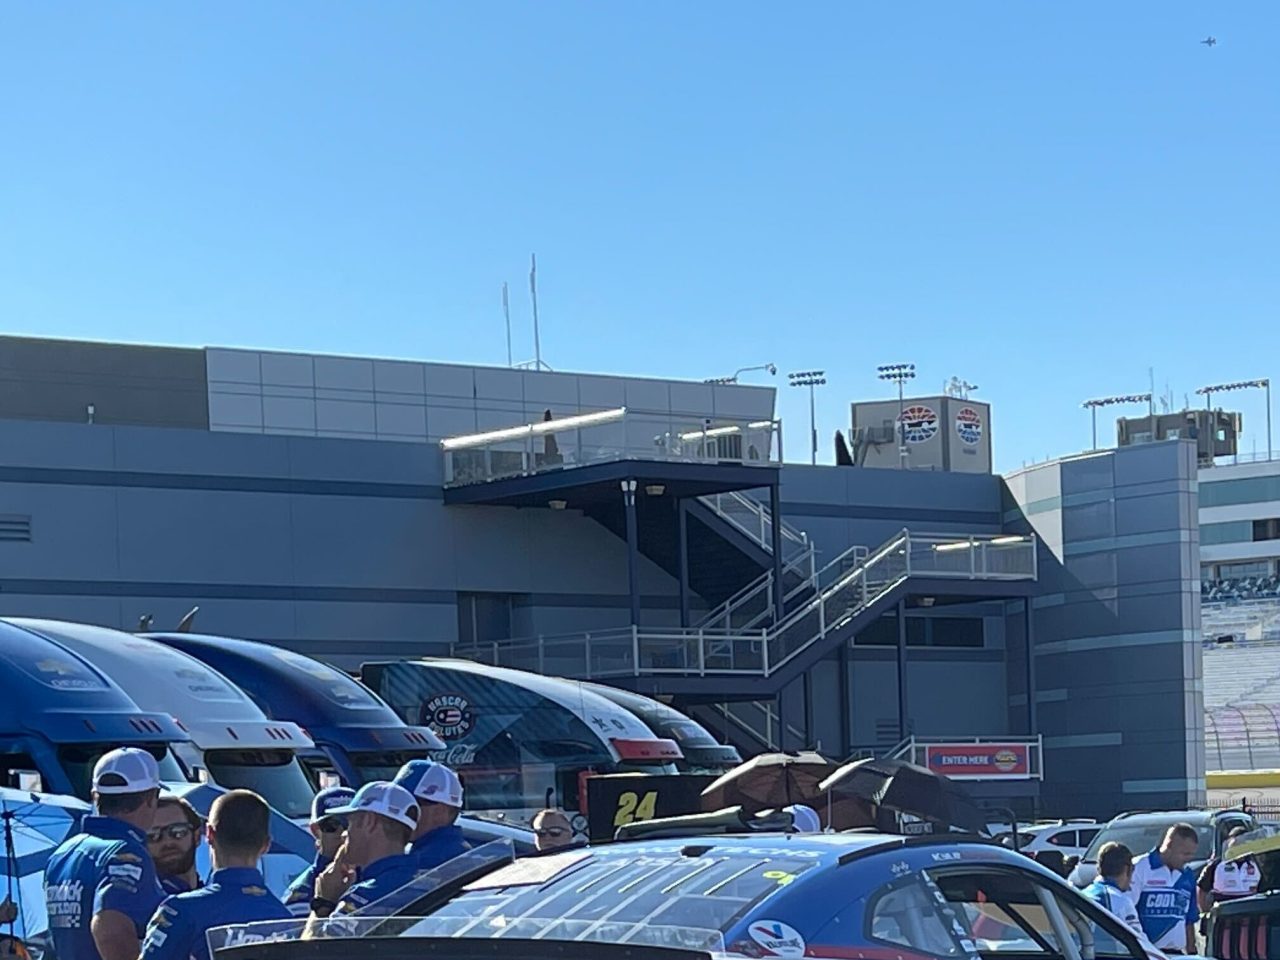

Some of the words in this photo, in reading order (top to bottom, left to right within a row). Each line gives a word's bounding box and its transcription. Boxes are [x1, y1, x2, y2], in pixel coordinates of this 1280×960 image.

[428, 696, 468, 711] NASCAR
[942, 756, 968, 765] ENTER
[969, 756, 989, 765] HERE
[614, 791, 658, 827] 24
